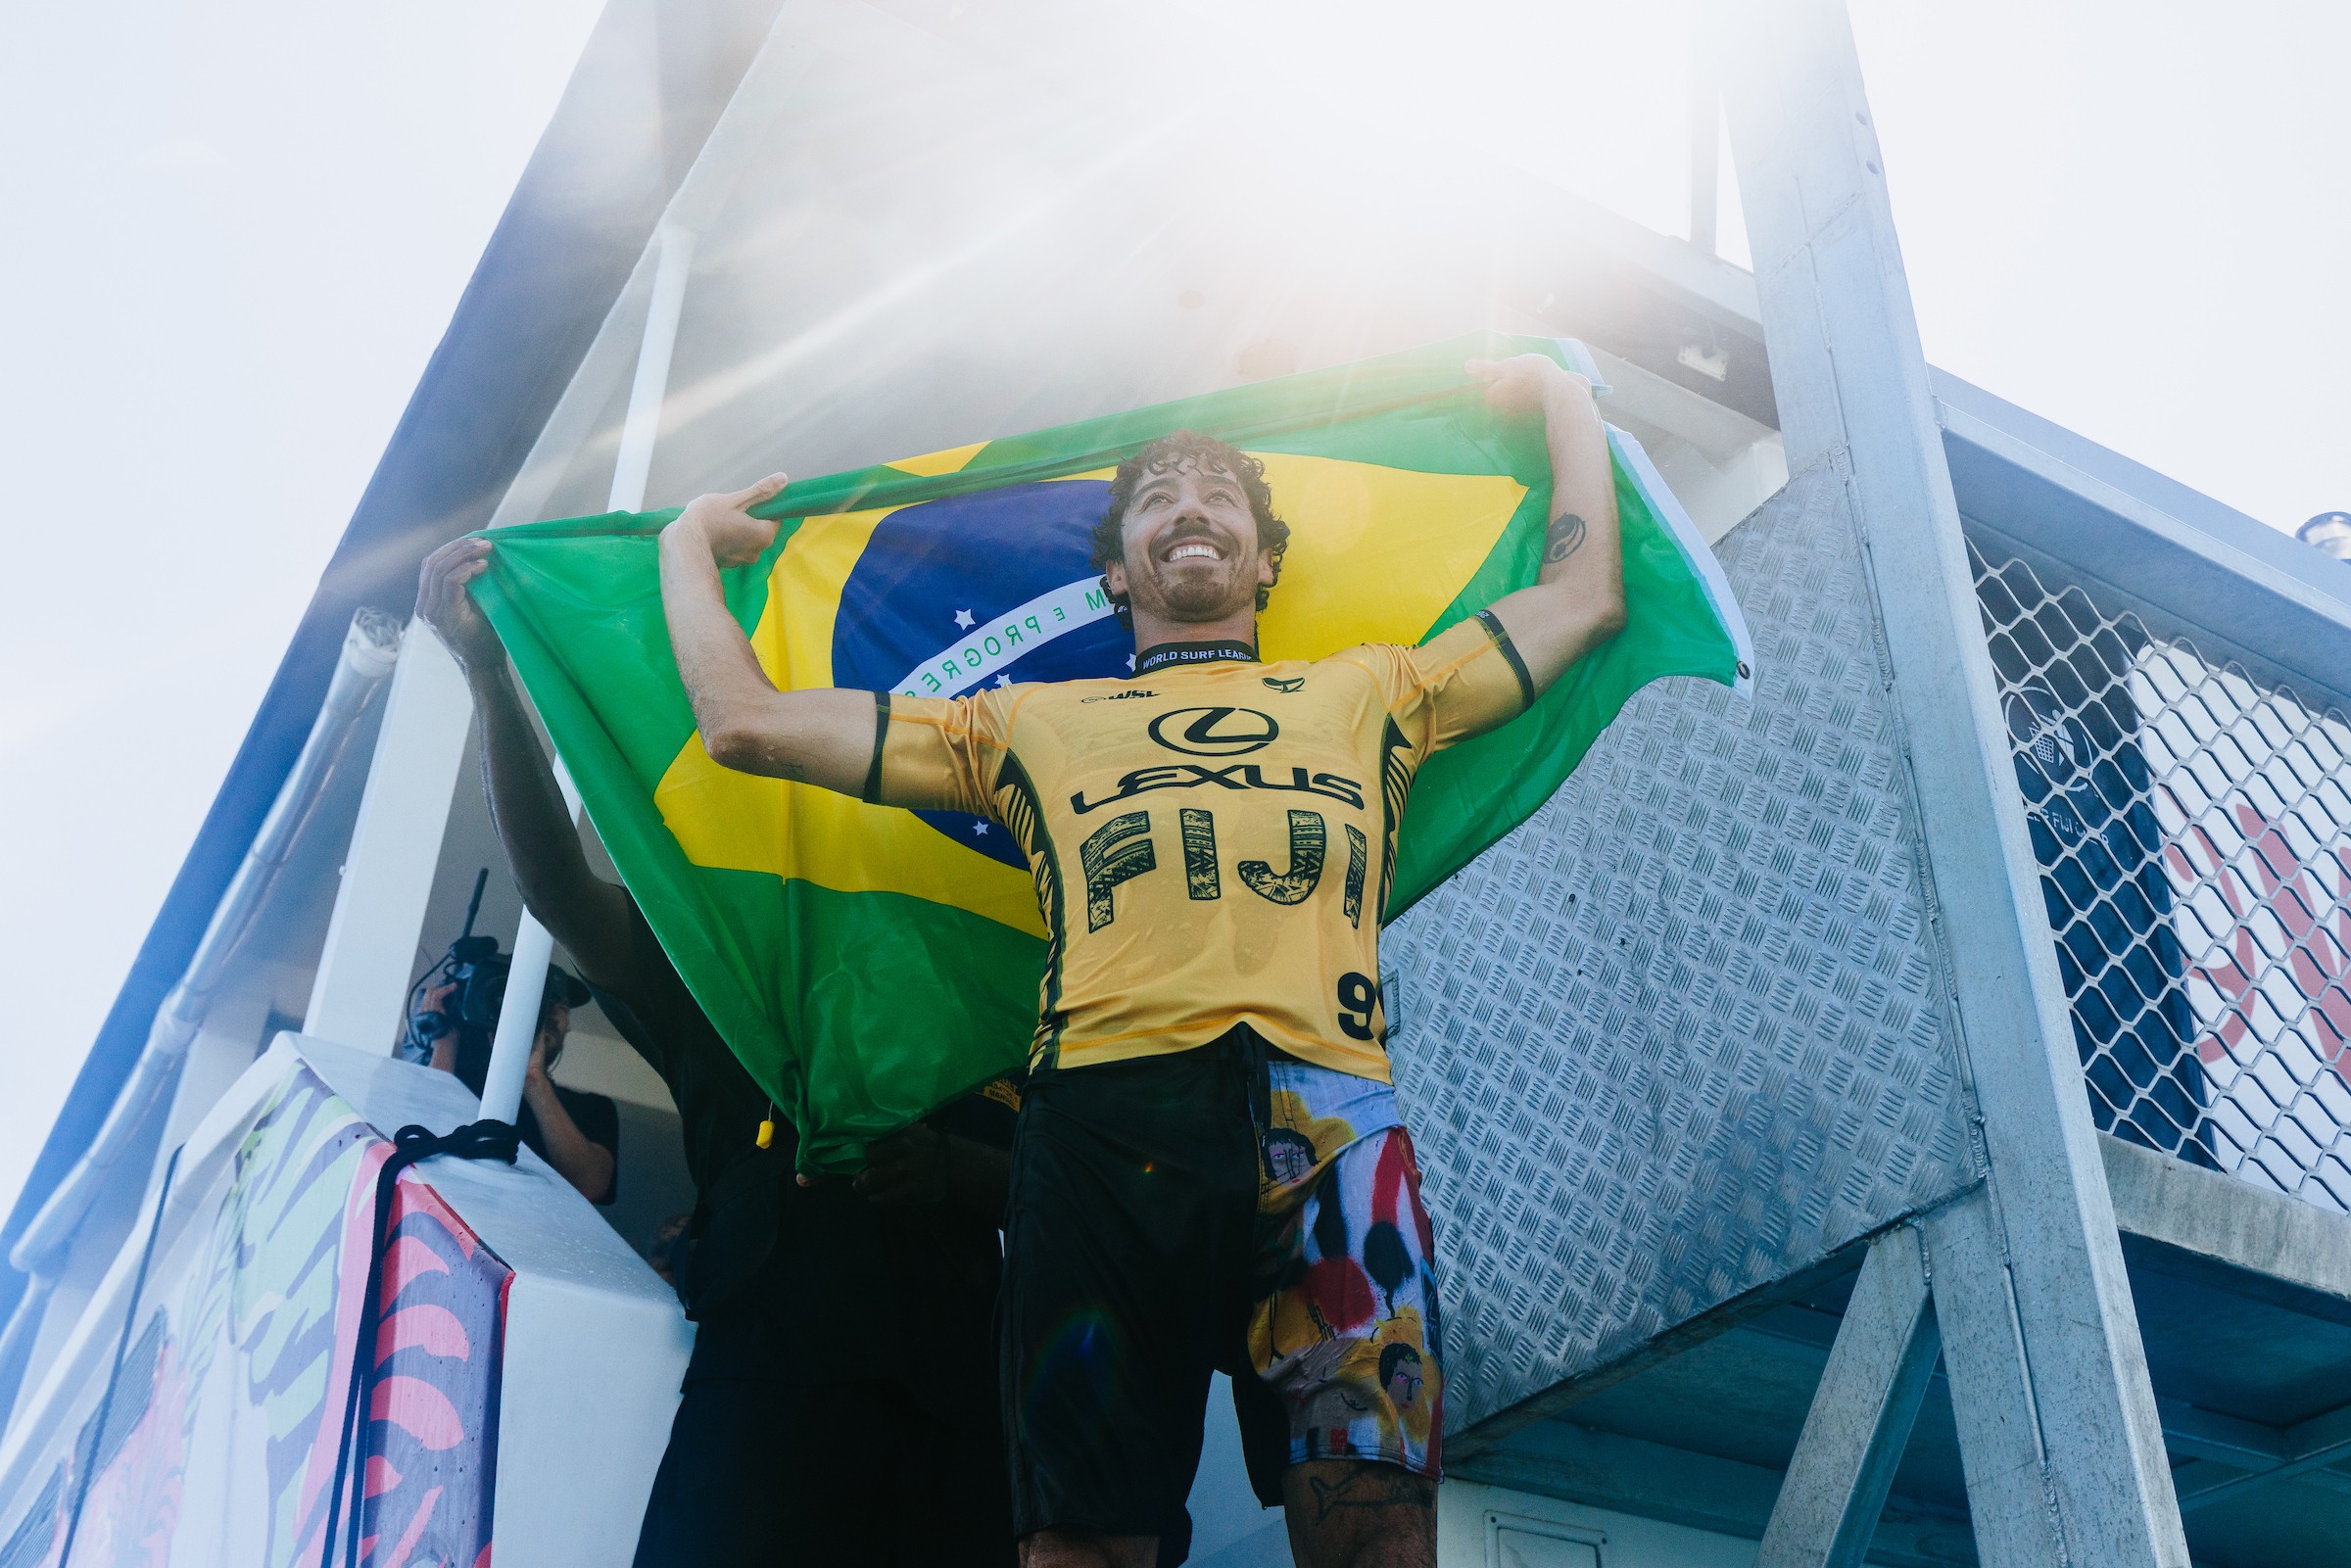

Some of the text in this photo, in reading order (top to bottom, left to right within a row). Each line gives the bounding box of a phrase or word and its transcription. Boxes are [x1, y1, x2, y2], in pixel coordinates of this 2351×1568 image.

[1142, 651, 1177, 670] WORLD
[1180, 649, 1216, 660] SURF
[1070, 764, 1365, 815] LEXUS
[1080, 808, 1367, 934] FIJI
[1337, 972, 1376, 1041] 9
